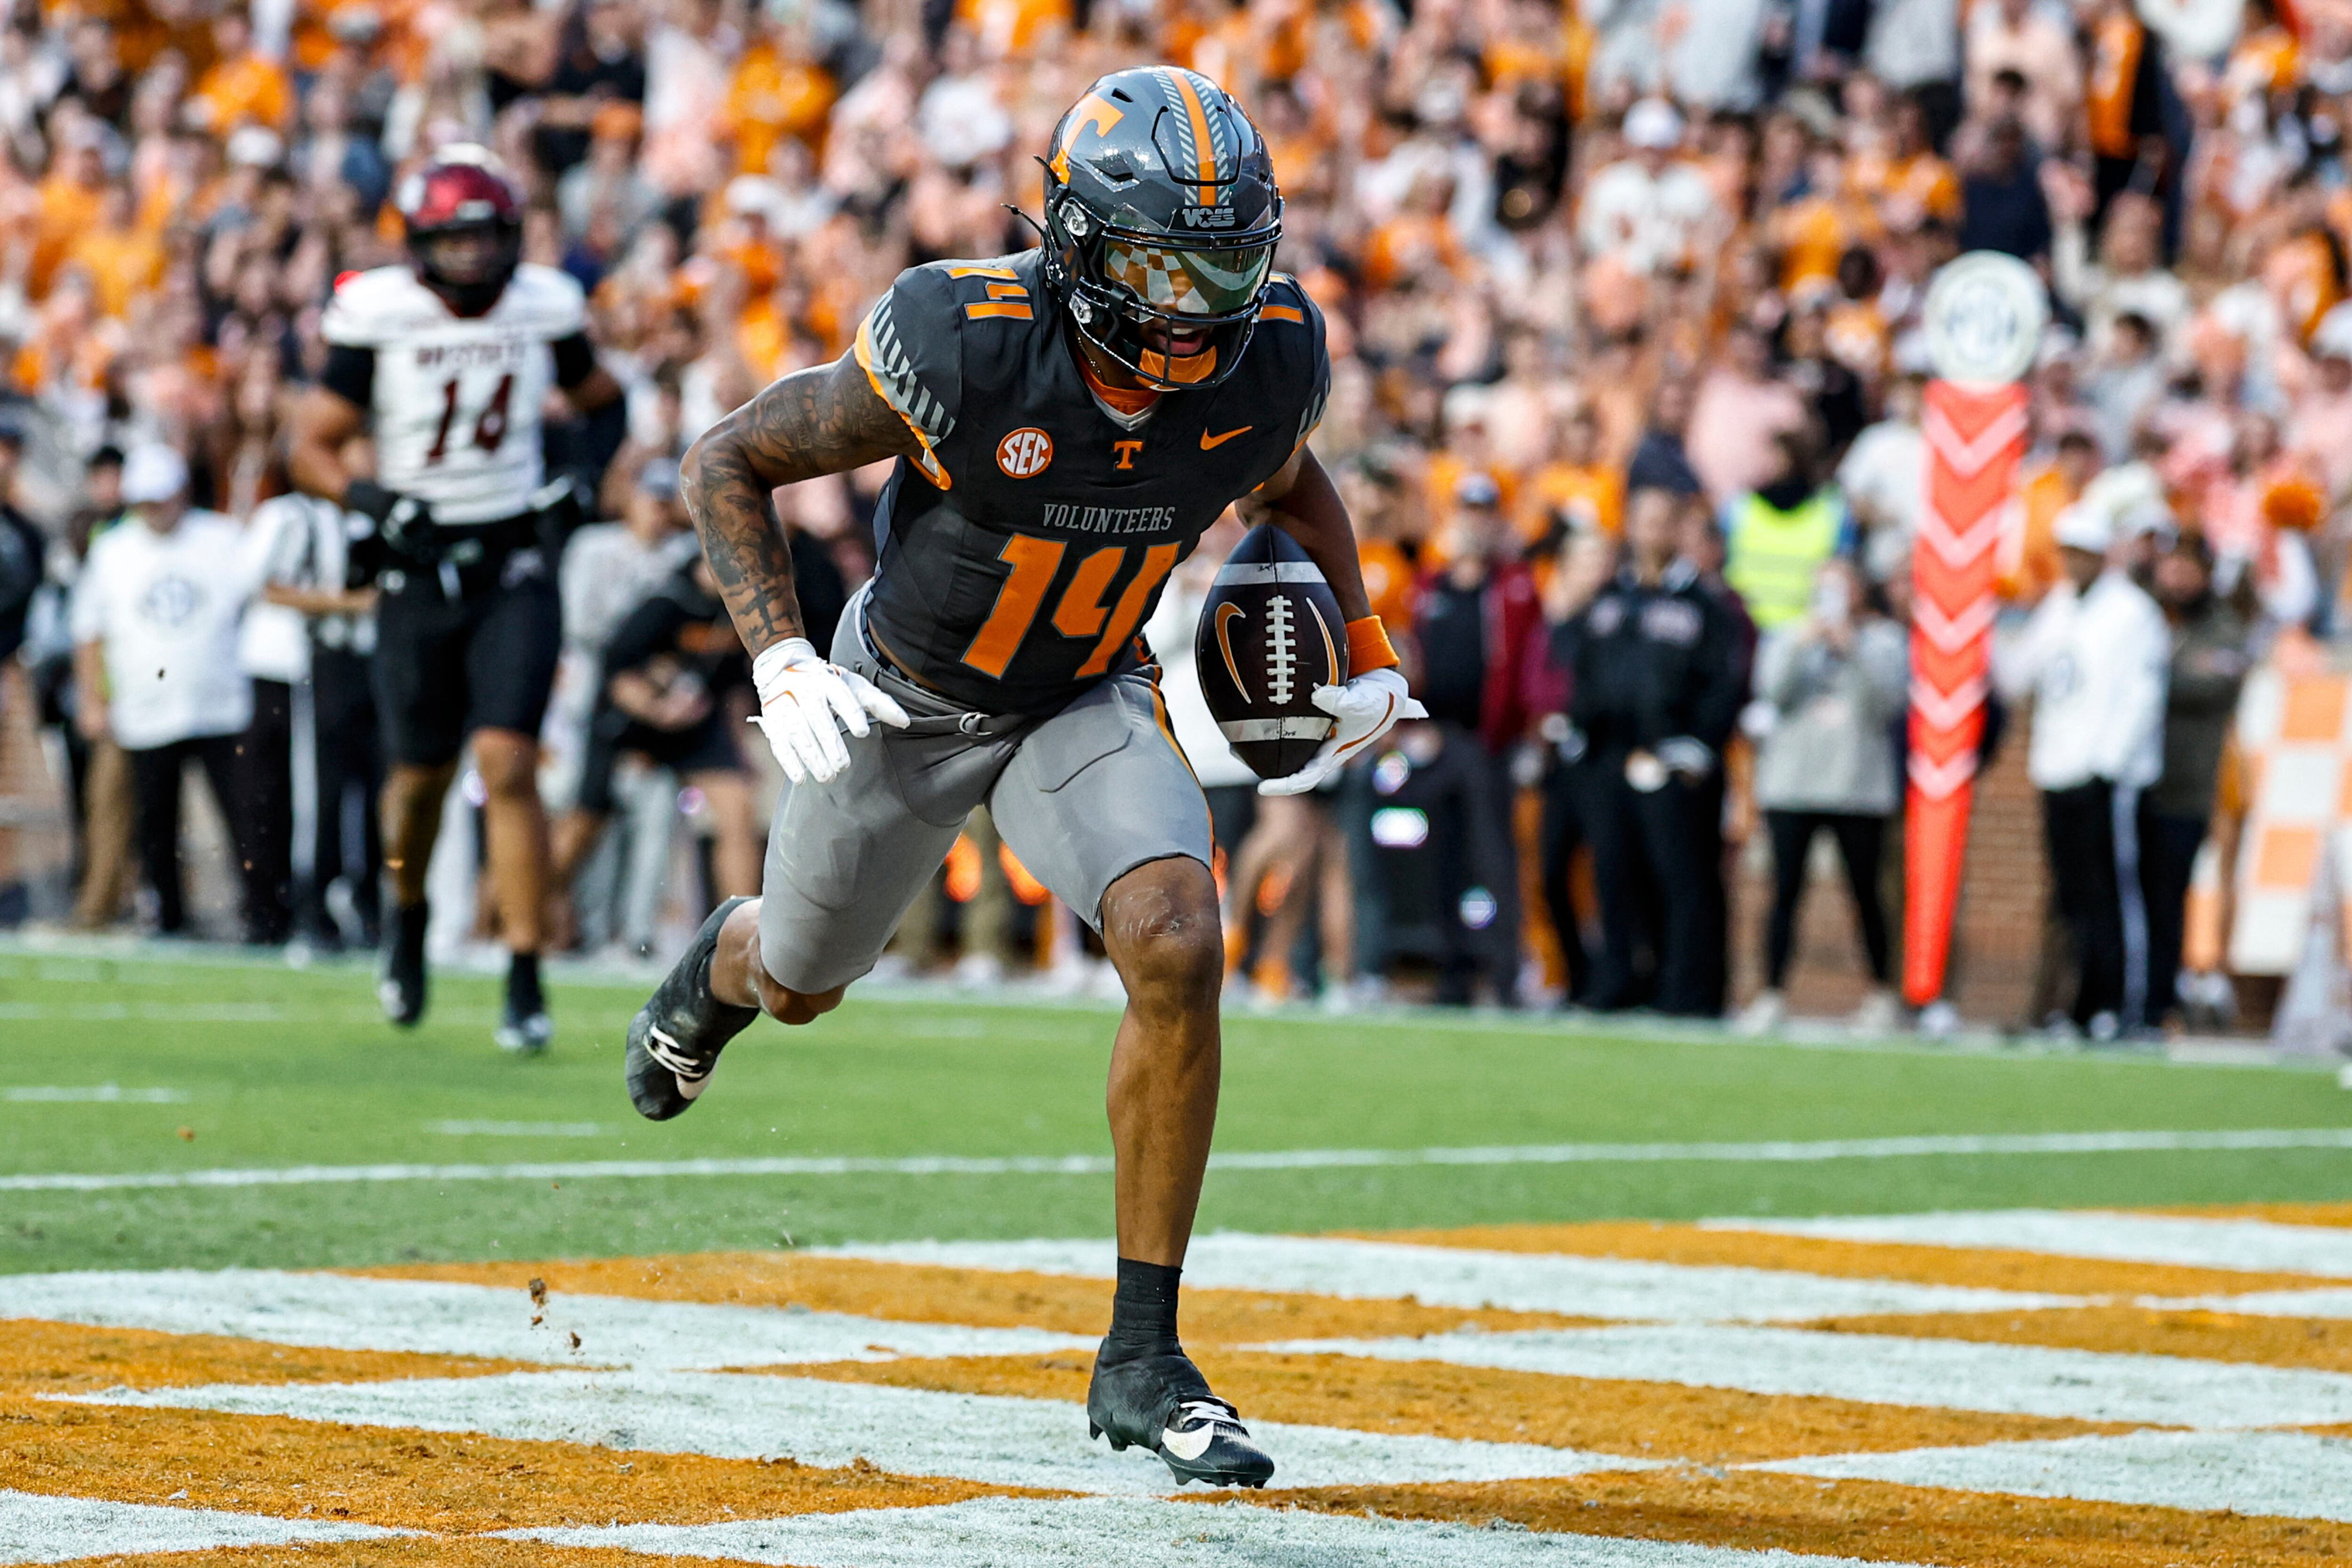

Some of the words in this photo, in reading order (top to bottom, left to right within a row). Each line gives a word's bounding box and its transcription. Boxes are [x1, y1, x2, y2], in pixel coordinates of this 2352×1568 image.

[426, 373, 514, 466] 14
[1002, 432, 1050, 475] SEC
[1113, 440, 1144, 470] T
[1043, 503, 1176, 533] VOLUNTEERS
[959, 532, 1182, 681] 14
